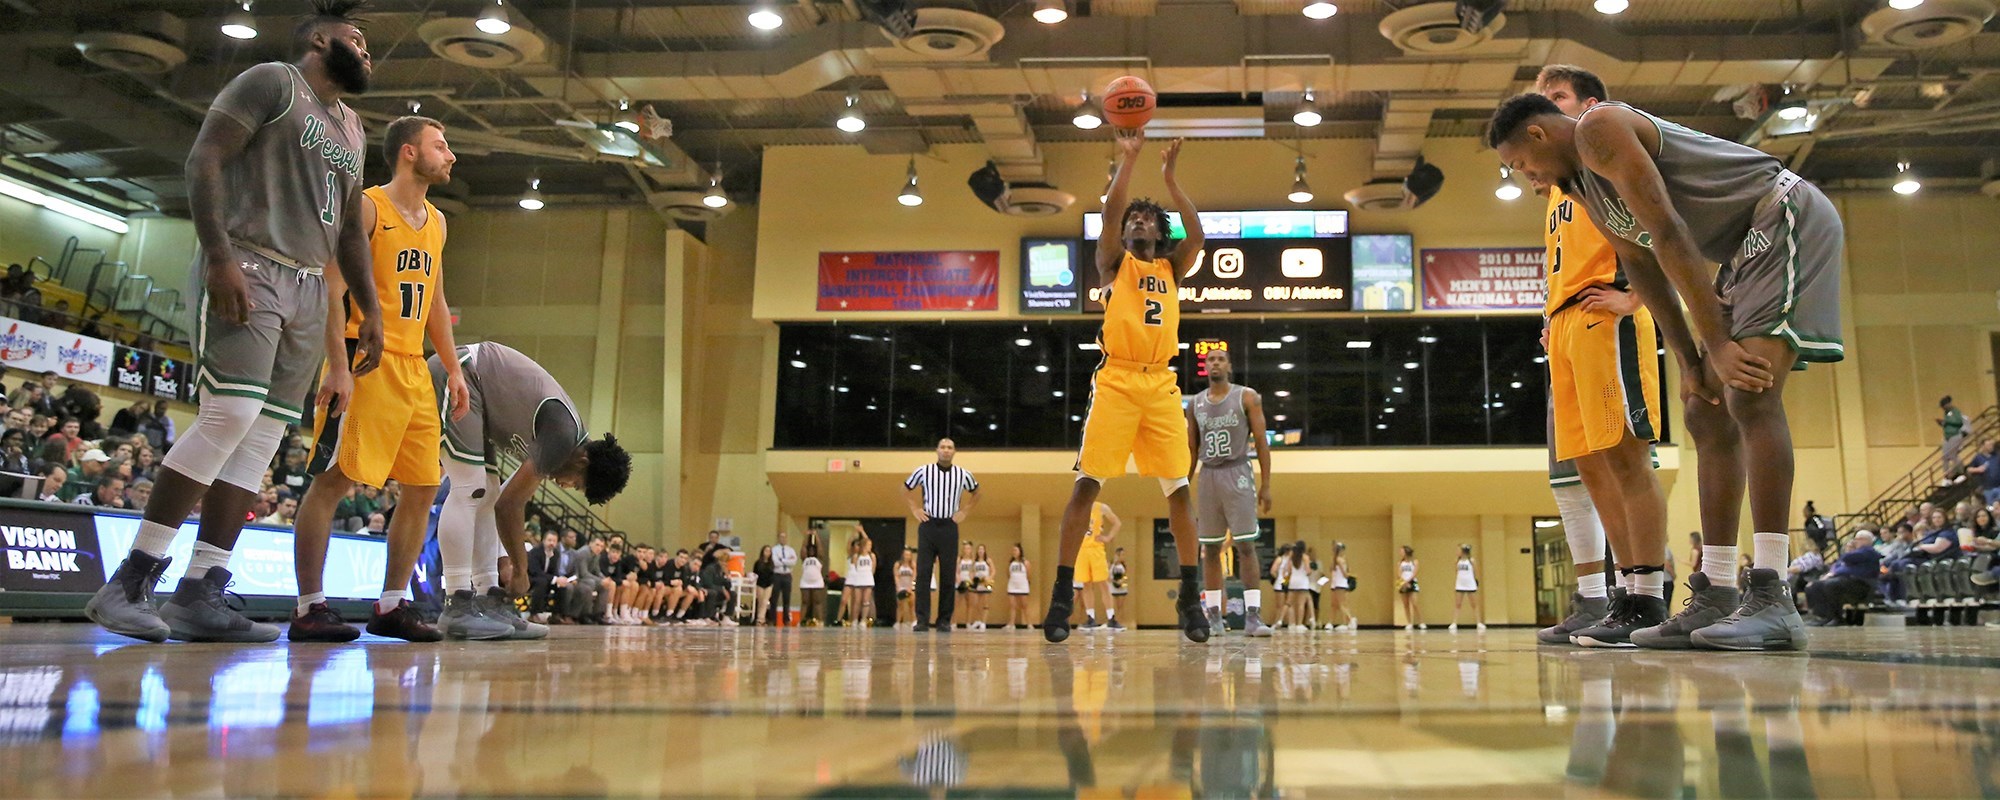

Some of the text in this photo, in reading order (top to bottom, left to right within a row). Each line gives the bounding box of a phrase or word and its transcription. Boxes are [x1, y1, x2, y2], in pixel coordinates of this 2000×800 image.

[321, 170, 337, 226] 1
[397, 248, 432, 278] OBU
[875, 254, 942, 266] NATIONAL
[1479, 253, 1511, 265] 2010
[846, 268, 970, 281] INTERCOLLEGIATE
[1480, 266, 1538, 278] DIVISION
[821, 284, 898, 298] BASKETBALL
[1291, 286, 1344, 300] Athletics
[1450, 280, 1545, 291] MEN'S BASKET
[399, 282, 425, 321] 11
[1446, 293, 1513, 305] NATIONAL
[1145, 298, 1162, 325] 2
[117, 367, 143, 387] Tack
[153, 375, 178, 395] Tack
[1206, 429, 1232, 458] 32
[0, 525, 77, 550] VISION
[7, 549, 81, 572] BANK
